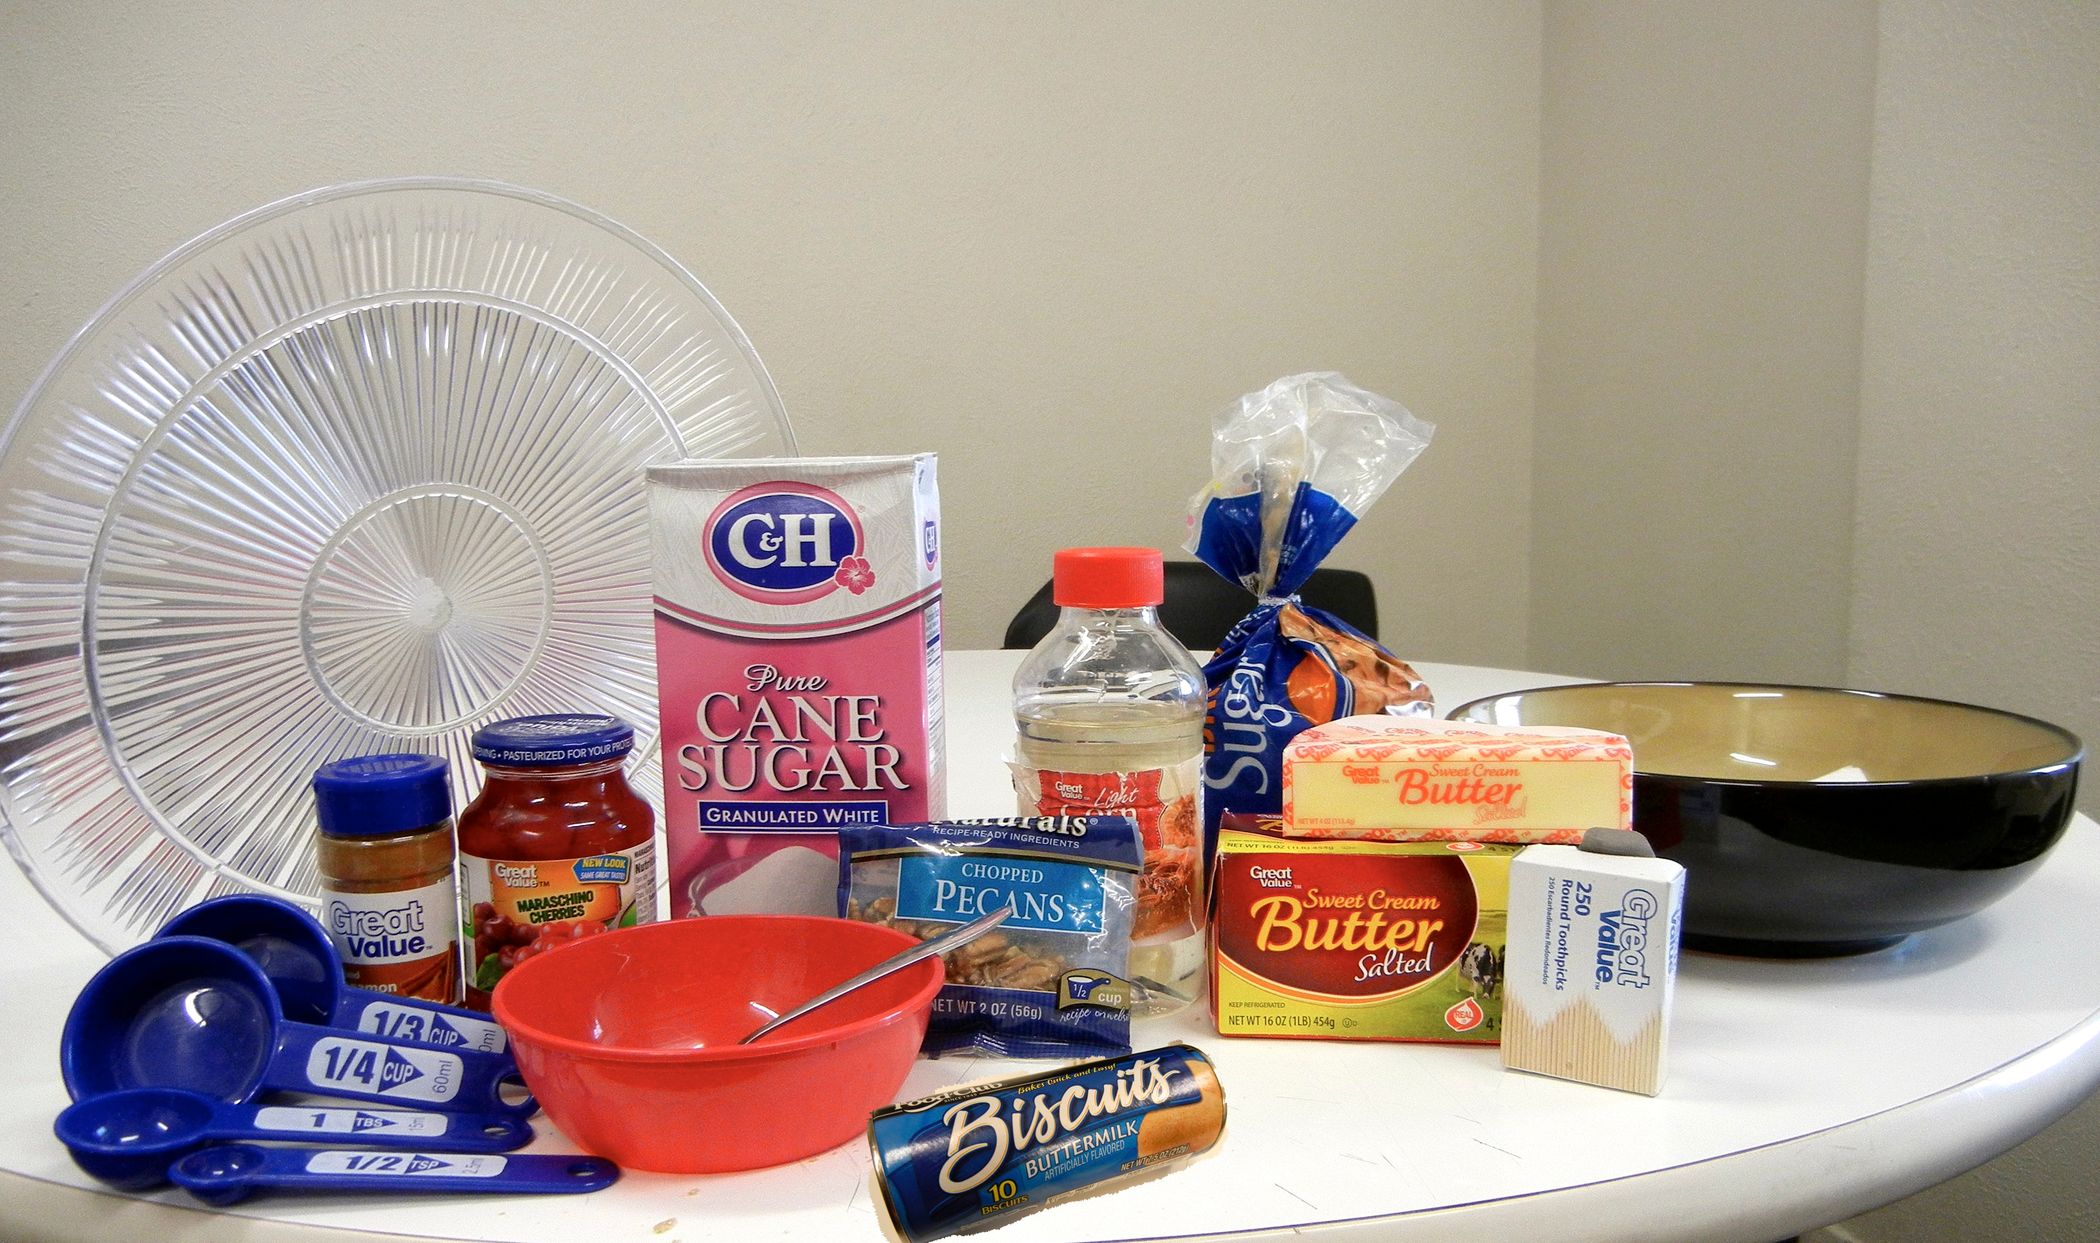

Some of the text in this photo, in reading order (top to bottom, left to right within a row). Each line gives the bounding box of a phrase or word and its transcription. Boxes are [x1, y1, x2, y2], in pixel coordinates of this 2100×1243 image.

[727, 512, 840, 570] C&H
[743, 664, 828, 694] Pure
[696, 692, 885, 744] CANE
[1204, 655, 1293, 795] Sugar
[503, 750, 566, 761] PASTEURIZED
[567, 748, 587, 759] FOR
[587, 744, 611, 757] YOUR
[677, 743, 911, 793] SUGAR
[1342, 765, 1381, 777] Great
[1429, 763, 1520, 777] Sweet Cream
[1055, 781, 1083, 794] Great
[1352, 776, 1380, 785] Value
[1395, 768, 1523, 806] Butter
[1062, 791, 1083, 799] Value
[1094, 786, 1139, 809] Light
[706, 806, 880, 824] GRANULATED WHITE
[932, 827, 1081, 849] RECIPE-READY INGREDIENTS
[494, 863, 537, 879] Great
[582, 858, 626, 868] NEW LOOK
[961, 862, 1044, 883] CHOPPED
[1250, 865, 1293, 880] Great
[504, 876, 538, 888] Value
[1260, 877, 1293, 888] Value
[516, 890, 594, 912] MARASCHINO
[932, 879, 1065, 923] PECANS
[1303, 888, 1441, 911] Sweet Cream
[1574, 881, 1593, 917] 250
[329, 899, 425, 937] Great
[529, 905, 585, 925] CHERRIES
[1250, 895, 1444, 953] Butter
[1554, 879, 1574, 991] Round Toothpicks
[1617, 888, 1658, 989] Great
[347, 935, 426, 958] Value
[1596, 909, 1622, 984] Value
[1353, 942, 1435, 982] Salted
[957, 999, 977, 1014] WT
[979, 1002, 988, 1015] 2
[991, 1002, 1007, 1016] OZ
[1010, 1003, 1043, 1020] (56g)
[1098, 993, 1122, 1006] cup
[1243, 1001, 1286, 1009] REFRIGERATED
[1228, 1015, 1336, 1029] NET WT 16 OZ (1LB) 454g
[1455, 1010, 1474, 1019] REAL
[1486, 1017, 1495, 1031] 4
[373, 1010, 426, 1041] 1/3
[428, 1028, 458, 1046] CUP
[325, 1045, 453, 1095] 1/4 CUP 60ml
[1018, 1083, 1045, 1095] Bakes
[1047, 1074, 1072, 1086] Quick
[1073, 1069, 1091, 1078] and
[311, 1113, 384, 1128] 1 TBS
[938, 1056, 1181, 1194] Biscuits
[1025, 1119, 1140, 1179] BUTTERMILK
[346, 1155, 440, 1171] 1/2 TSP
[1044, 1140, 1125, 1182] ARTIFICIALLY FLAVORED
[988, 1180, 1018, 1203] 10
